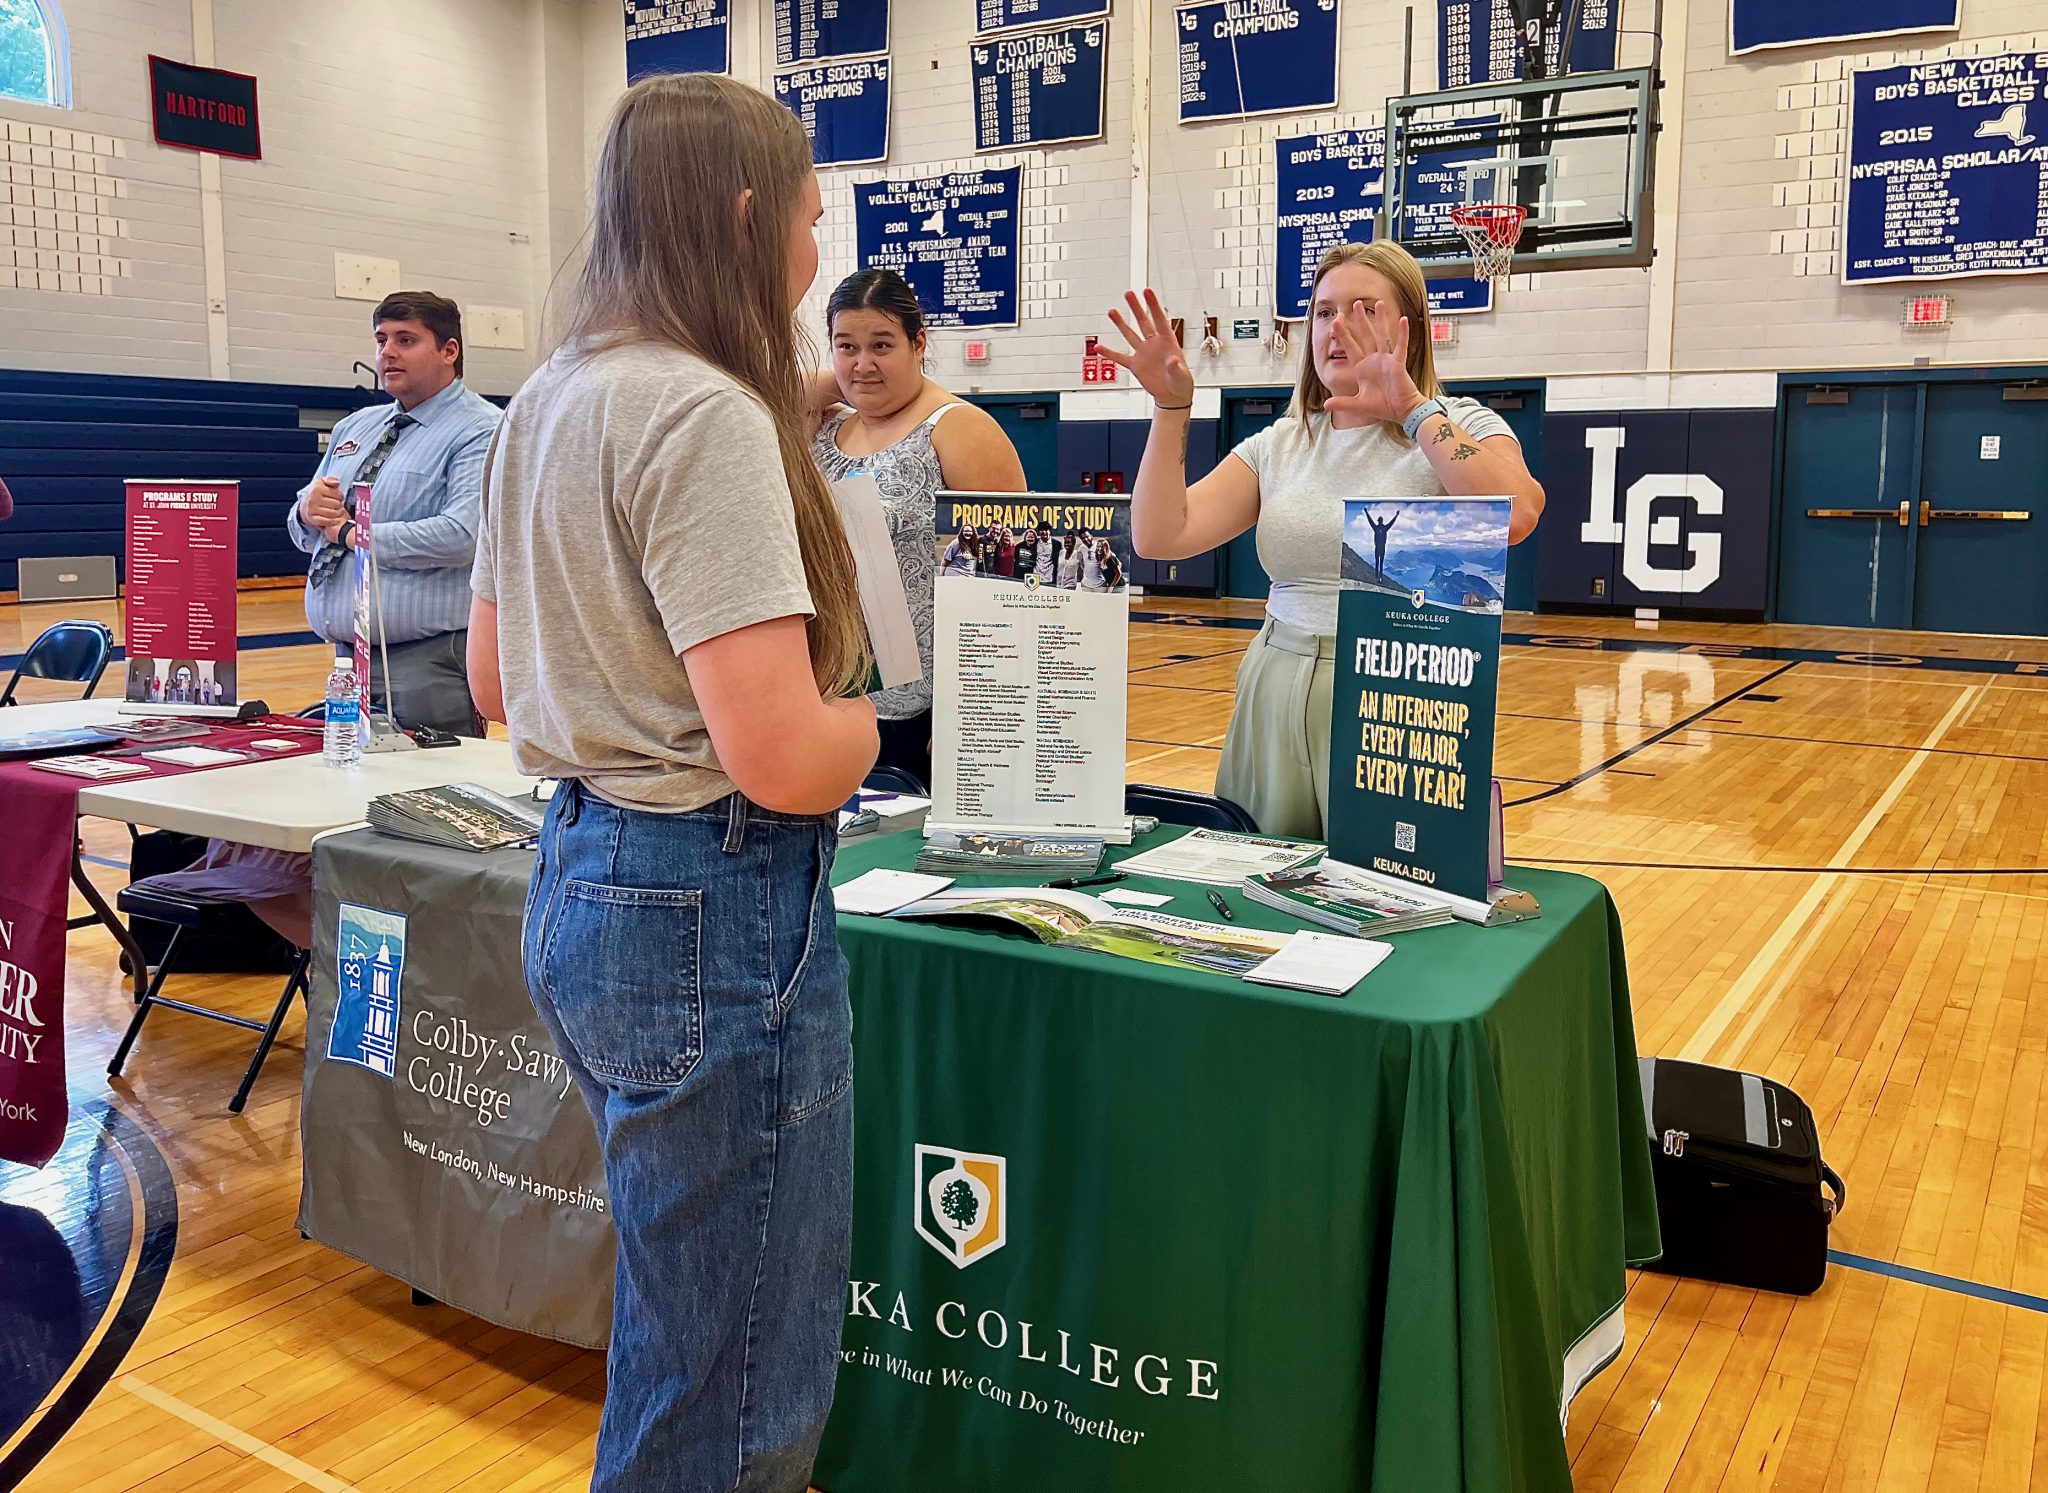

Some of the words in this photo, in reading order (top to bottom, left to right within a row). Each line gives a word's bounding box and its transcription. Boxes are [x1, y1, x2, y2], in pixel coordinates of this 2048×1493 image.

[1224, 0, 1290, 20] VOLLEYBALL
[1446, 3, 1470, 15] 1933
[1213, 11, 1299, 39] CHAMPIONS
[1447, 14, 1471, 25] 1934
[1490, 18, 1515, 30] 2001
[1447, 24, 1471, 36] 1989
[1490, 29, 1516, 40] 2002
[1528, 20, 1539, 43] 2
[998, 32, 1074, 58] FOOTBALL
[1447, 34, 1471, 46] 1990
[1489, 38, 1516, 50] 2003
[1181, 42, 1199, 53] 2017
[1447, 44, 1470, 57] 1991
[996, 47, 1076, 74] CHAMPIONS
[1181, 53, 1199, 63] 2018
[1447, 54, 1471, 66] 1992
[1489, 58, 1516, 70] 2005
[1042, 66, 1061, 76] 2001
[1447, 65, 1471, 77] 1993
[1489, 69, 1515, 80] 2006
[1910, 62, 1957, 81] NEW
[1965, 55, 2026, 75] YORK
[791, 70, 823, 88] GIRLS
[827, 64, 872, 82] SOCCER
[1181, 72, 1200, 83] 2020
[1447, 75, 1471, 87] 1994
[801, 81, 863, 103] CHAMPIONS
[1181, 83, 1199, 93] 2021
[1875, 82, 1919, 101] BOYS
[1924, 70, 2040, 95] BASKETBALL
[980, 93, 998, 103] 1969
[1957, 87, 2035, 107] CLASS
[166, 91, 247, 127] HARTFORD
[981, 102, 997, 112] 1971
[981, 111, 998, 121] 1972
[981, 120, 999, 129] 1974
[982, 128, 999, 138] 1975
[1879, 126, 1933, 146] 2015
[1317, 133, 1350, 149] NEW
[1291, 149, 1322, 165] BOYS
[1852, 157, 1937, 180] NYSPHSAA
[887, 182, 909, 194] NEW
[916, 178, 944, 191] YORK
[948, 173, 983, 186] STATE
[1418, 172, 1454, 184] OVERALL
[1457, 169, 1490, 181] REORD
[868, 190, 938, 206] VOLLEYBALL
[943, 183, 1005, 198] CHAMPIONS
[1296, 186, 1335, 202] 2013
[1886, 183, 1905, 193] KYLE
[1886, 193, 1906, 203] CRAIG
[911, 200, 947, 214] CLASS
[1886, 202, 1913, 212] ANDREW
[958, 212, 983, 222] OVERALL
[1278, 209, 1337, 228] NYSPHSAA
[1885, 211, 1912, 221] DUNCAN
[885, 222, 908, 234] 2001
[1884, 229, 1907, 238] DYLAN
[908, 238, 963, 252] SPORTSMANSHIP
[967, 235, 991, 247] AWARD
[1954, 244, 1972, 252] HEAD
[2000, 240, 2018, 249] DAVE
[2020, 238, 2044, 247] JONES
[868, 254, 913, 265] NYSPHSAA
[918, 248, 982, 262] SCHOLAR/ATHLETE
[988, 246, 1007, 258] TEAM
[1909, 255, 1920, 265] TIM
[1969, 260, 1990, 270] KEITH
[143, 492, 185, 501] PROGRAMS
[192, 493, 218, 502] STUDY
[952, 503, 1039, 529] PROGRAMS
[1042, 505, 1062, 531] OF
[1064, 506, 1115, 531] STUDY
[993, 594, 1025, 602] KEUKA
[1027, 595, 1071, 603] COLLEGE
[1385, 611, 1412, 620] KEUKA
[1413, 613, 1450, 624] COLLEGE
[1355, 637, 1402, 679] FIELD
[1358, 689, 1378, 719] AN
[1382, 693, 1470, 739] INTERNSHIP,
[1361, 722, 1406, 757] EVERY
[1409, 730, 1463, 772] MAJOR,
[1355, 754, 1408, 798] EVERY
[1413, 765, 1467, 811] YEAR!
[1373, 856, 1436, 884] KEUKA.EDU
[1150, 914, 1192, 926] STARTS
[1195, 923, 1226, 931] WITH
[343, 934, 369, 990] 1837
[0, 1023, 44, 1064] ITY
[407, 1055, 513, 1127] College
[403, 1130, 427, 1157] New
[430, 1141, 483, 1181] London,
[487, 1160, 517, 1188] New
[520, 1174, 605, 1213] Hampshire
[936, 1300, 1220, 1401] COLLEGE
[862, 1345, 880, 1370] in
[885, 1353, 934, 1387] What
[941, 1367, 973, 1391] We
[977, 1376, 1013, 1408] Can
[1018, 1390, 1049, 1415] Do
[1053, 1400, 1146, 1446] Together
